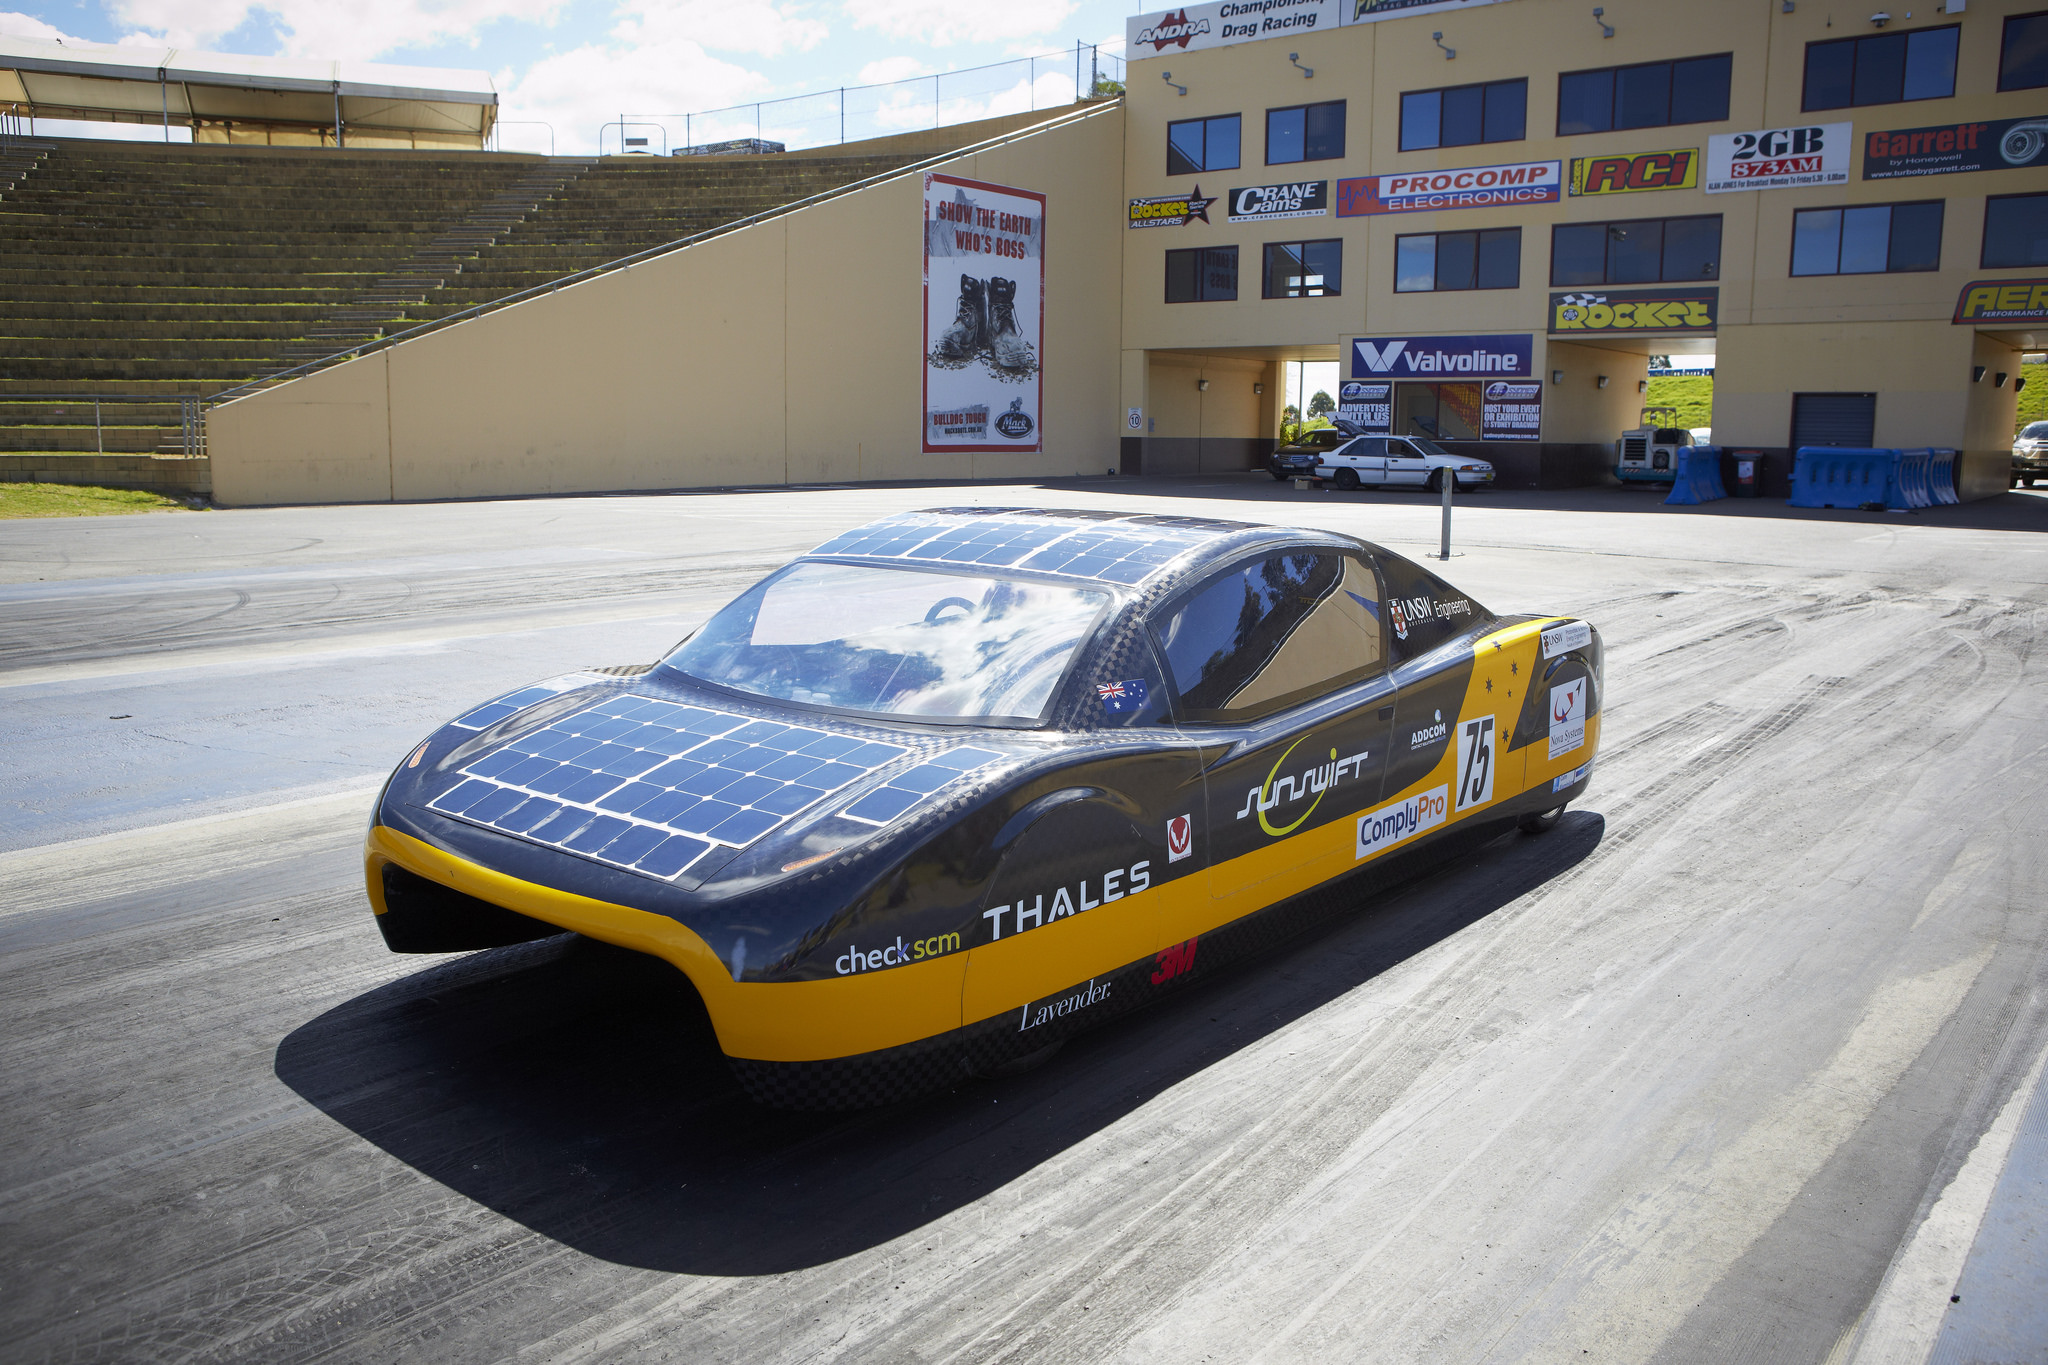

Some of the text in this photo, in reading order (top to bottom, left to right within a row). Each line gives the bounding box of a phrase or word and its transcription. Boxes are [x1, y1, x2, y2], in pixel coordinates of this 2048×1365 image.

[1135, 18, 1211, 45] ANDRA
[1221, 12, 1318, 38] Drag Racing
[1732, 127, 1824, 161] 2GB
[1869, 123, 1980, 158] Garrett
[1732, 157, 1820, 178] 873AM
[1905, 154, 1962, 165] Honeywell
[1389, 166, 1548, 195] PROCOMP
[1870, 163, 1980, 179] www.turbobygarrett.com
[1708, 181, 1720, 190] ALAN
[1721, 180, 1737, 189] JONES
[1770, 177, 1789, 186] Monday
[1790, 176, 1798, 184] To
[1797, 175, 1812, 184] Friday
[1388, 187, 1548, 210] ELECTRONICS
[938, 200, 1032, 236] SHOW THE EARTH
[1130, 217, 1183, 228] ALLSTARS
[1231, 210, 1325, 221] www.cranecams.com.au
[955, 229, 1025, 260] WHO'S BOSS
[1982, 310, 2044, 318] PERFORMANCE
[1404, 350, 1518, 372] Valvoline
[1340, 403, 1390, 412] ADVERTISE
[1373, 411, 1390, 420] US
[1484, 404, 1540, 413] HOST YOUR EVENT
[1484, 412, 1540, 422] OR EXHIBITION
[933, 412, 987, 426] BULLDOG TOUGH
[1131, 416, 1140, 425] 10
[1511, 421, 1539, 429] DRAGWAY
[1401, 596, 1471, 621] UNSW Engineering
[1411, 722, 1446, 745] ADDCOM
[1551, 726, 1584, 747] Nova Systems
[1457, 718, 1494, 806] 75
[1361, 795, 1444, 846] ComplyPro
[983, 860, 1150, 941] THALES
[1151, 935, 1199, 985] 3M
